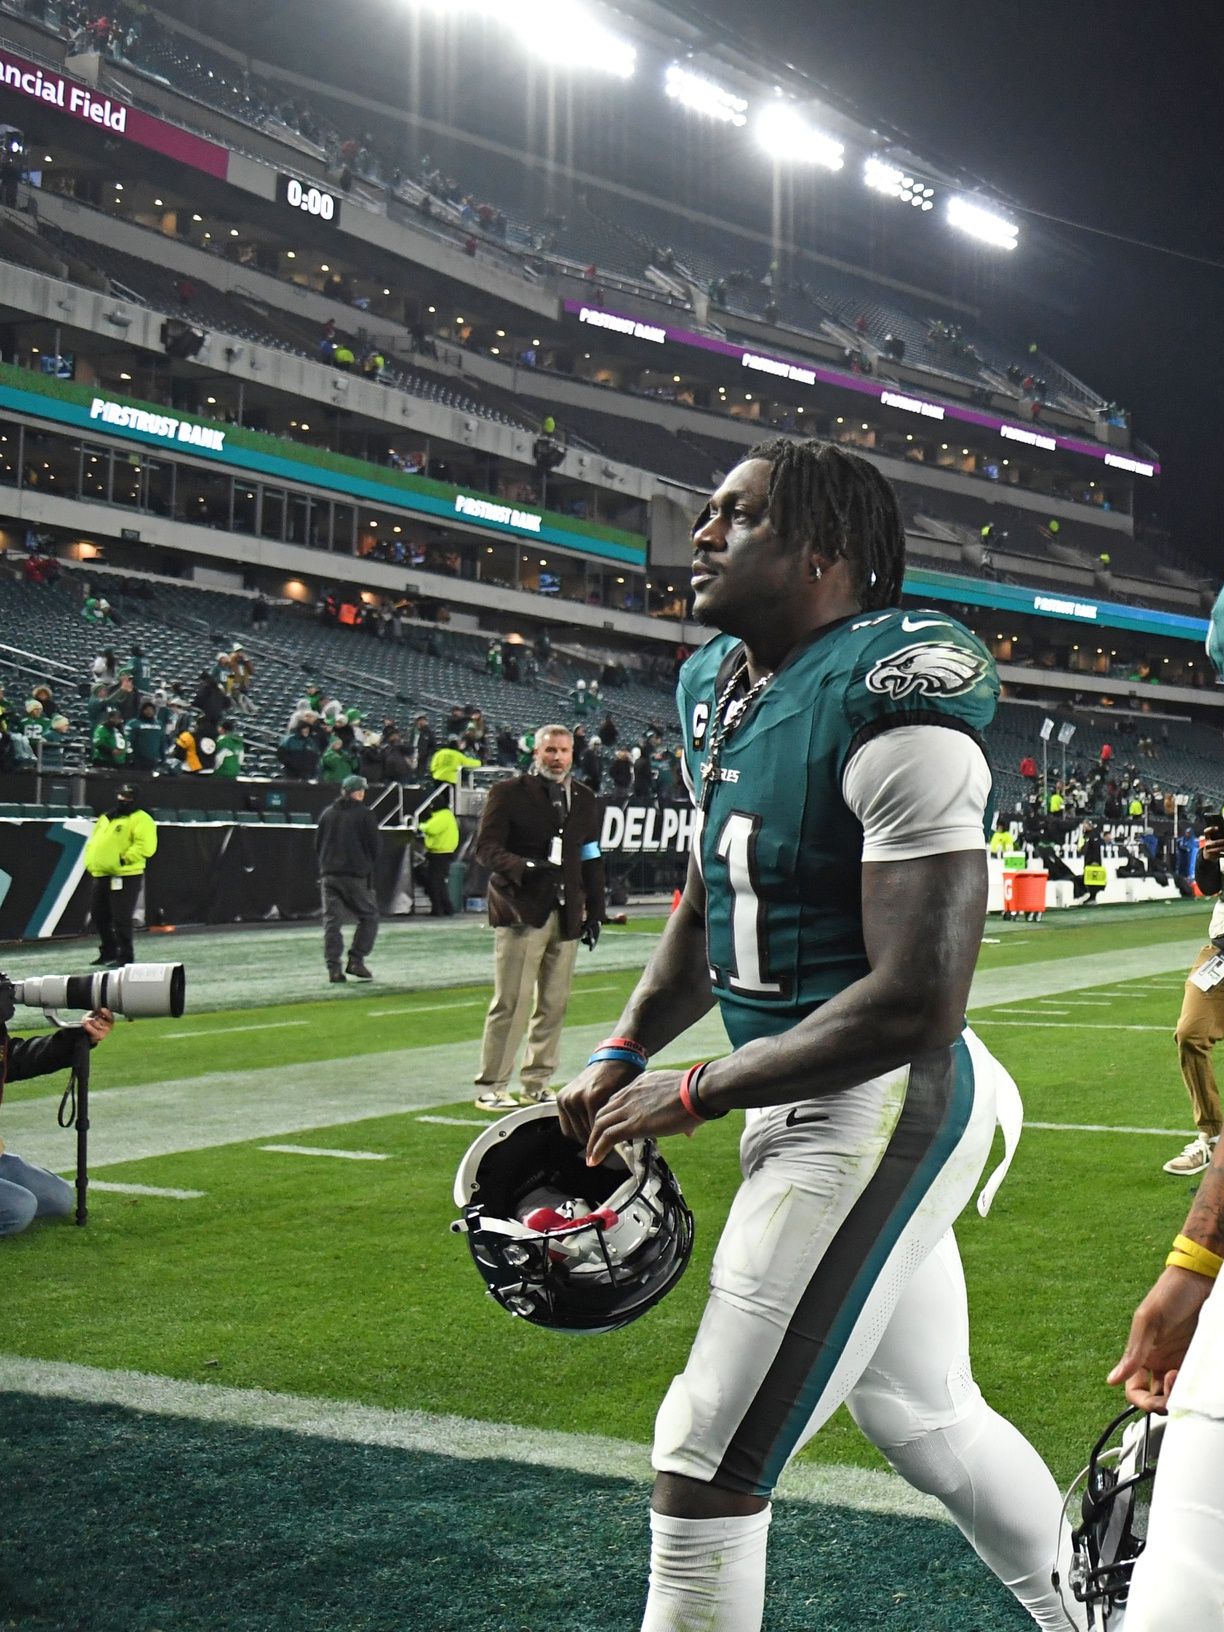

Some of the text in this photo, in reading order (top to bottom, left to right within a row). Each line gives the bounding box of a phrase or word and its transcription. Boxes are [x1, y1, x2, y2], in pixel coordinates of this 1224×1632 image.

[70, 87, 126, 133] Field
[287, 179, 334, 220] 0:00
[178, 421, 225, 451] BANK
[692, 703, 708, 739] C
[709, 812, 784, 996] 1
